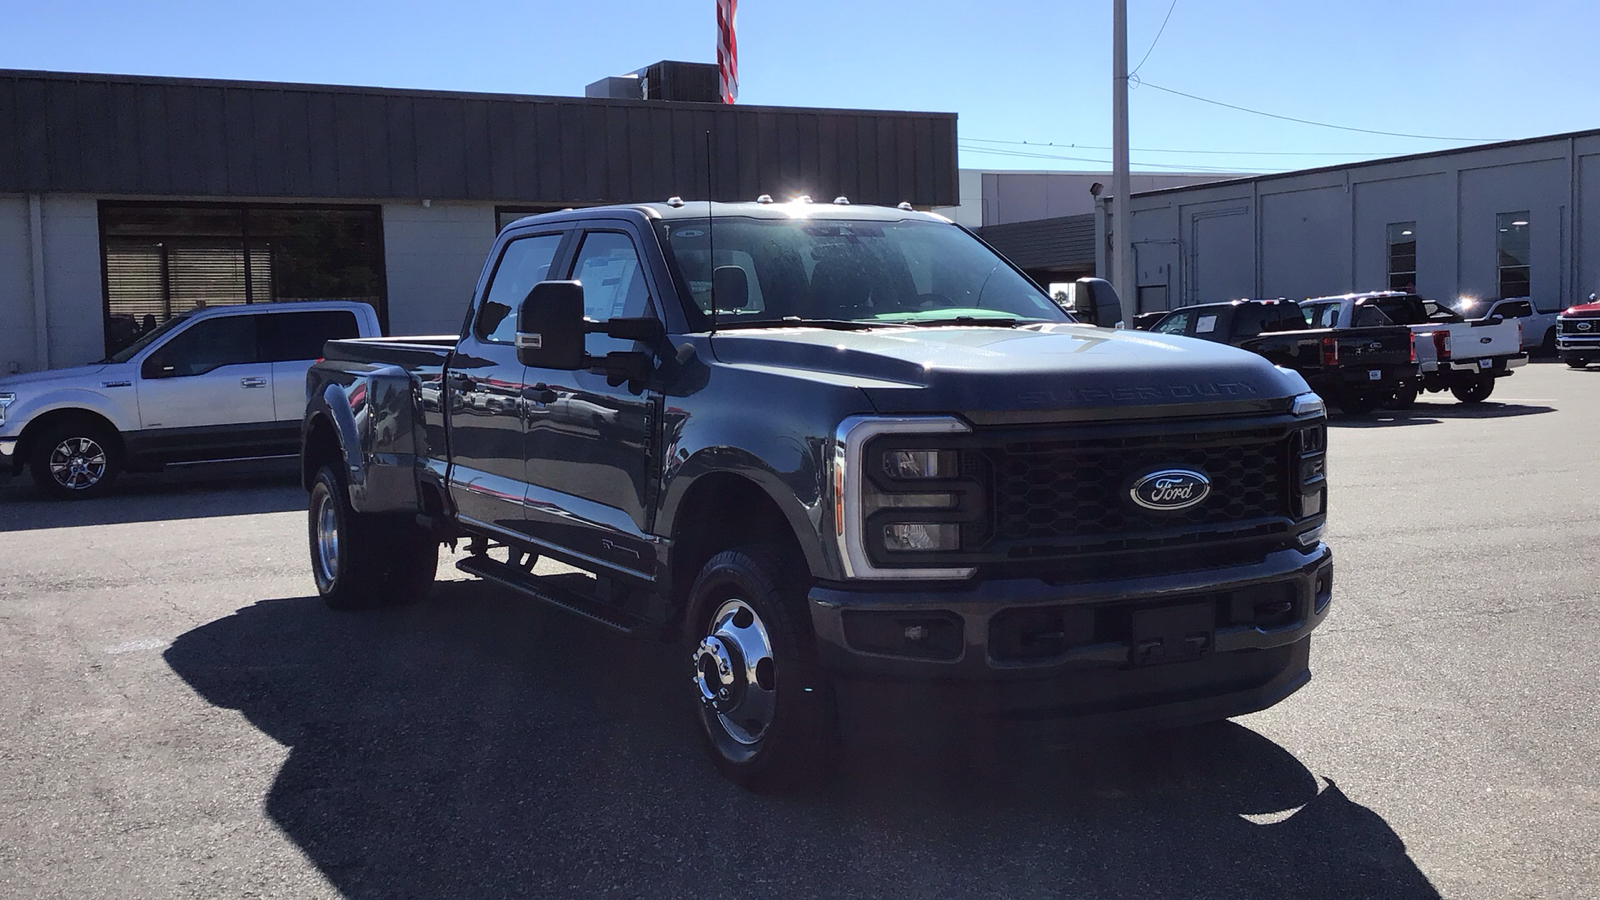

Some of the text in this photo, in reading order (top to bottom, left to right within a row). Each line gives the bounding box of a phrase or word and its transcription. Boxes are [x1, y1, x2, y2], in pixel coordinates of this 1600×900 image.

[1018, 381, 1257, 404] SUPER DUTY
[1151, 478, 1194, 502] Ford
